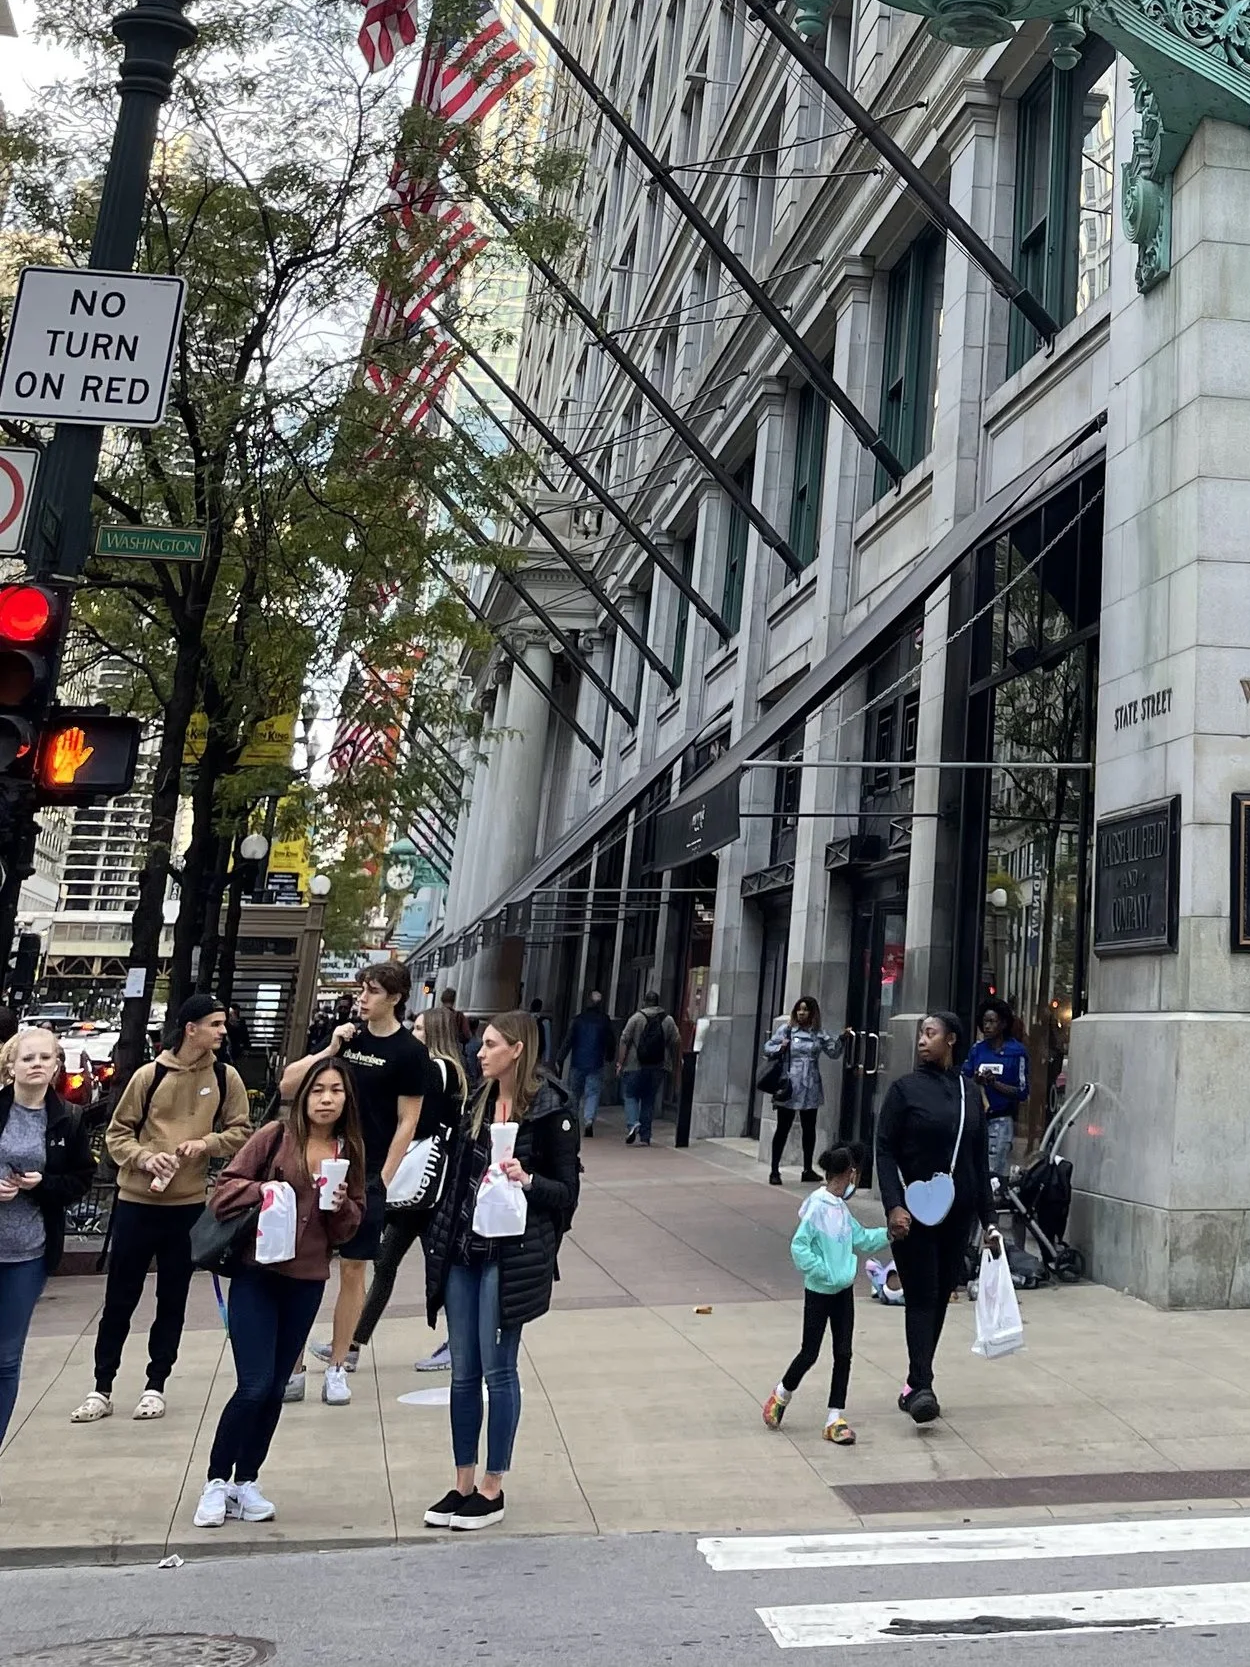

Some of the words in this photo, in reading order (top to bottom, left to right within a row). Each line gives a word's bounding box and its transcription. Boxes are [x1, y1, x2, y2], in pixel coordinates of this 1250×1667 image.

[69, 288, 126, 318] NO
[46, 329, 139, 362] TURN
[14, 370, 66, 401] ON
[80, 374, 150, 405] RED
[106, 532, 197, 554] WASHINGTON
[1113, 699, 1138, 732] STATE
[1140, 687, 1173, 722] STREET
[1111, 893, 1151, 934] COMPANY
